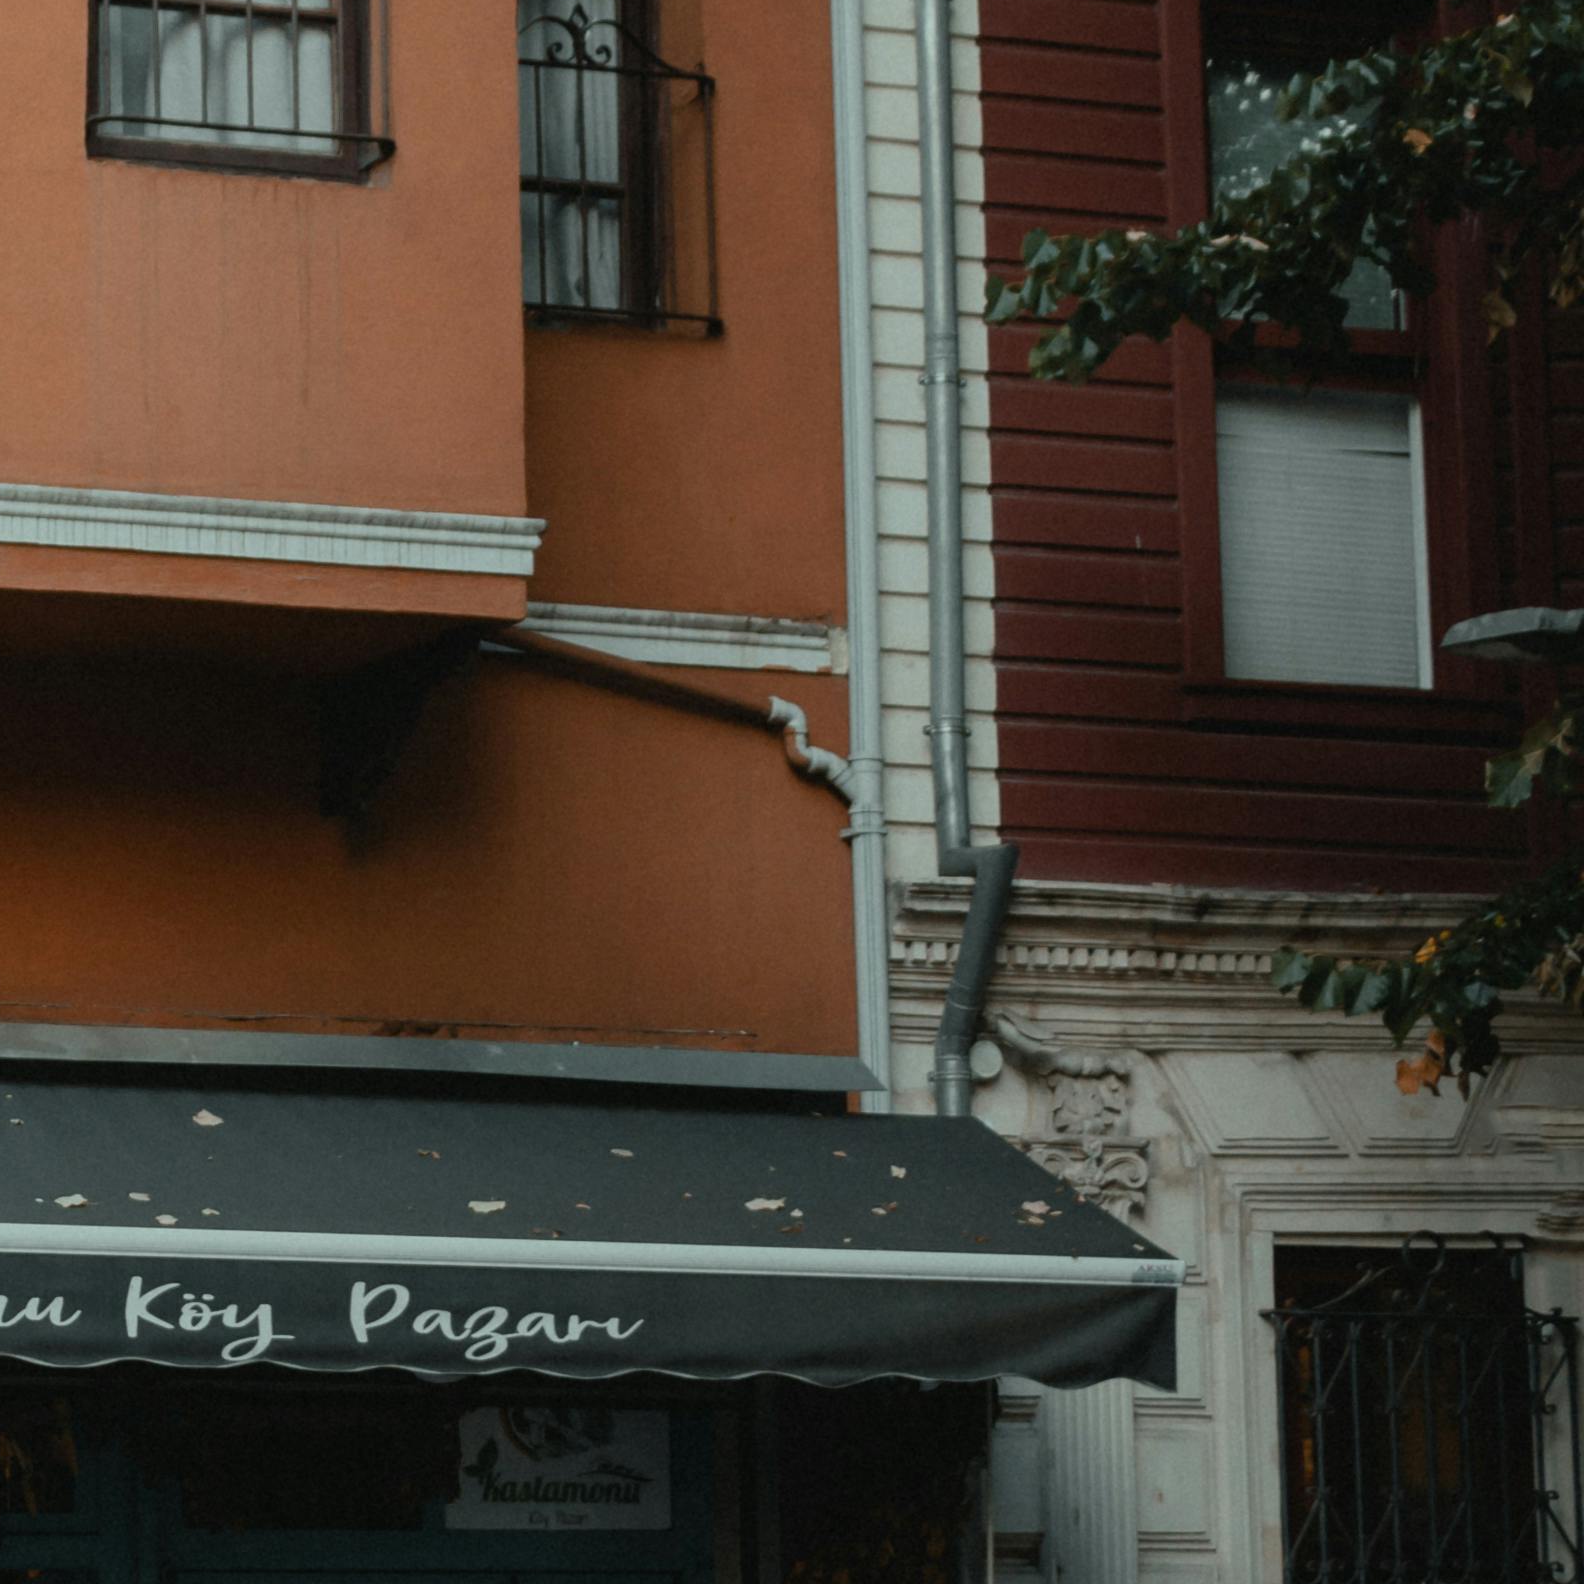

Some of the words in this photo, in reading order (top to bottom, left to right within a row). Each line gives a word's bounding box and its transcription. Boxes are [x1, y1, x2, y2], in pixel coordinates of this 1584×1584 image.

[125, 1276, 295, 1362] Köy
[349, 1281, 644, 1361] Pazarı
[481, 1473, 641, 1504] Kastamonu
